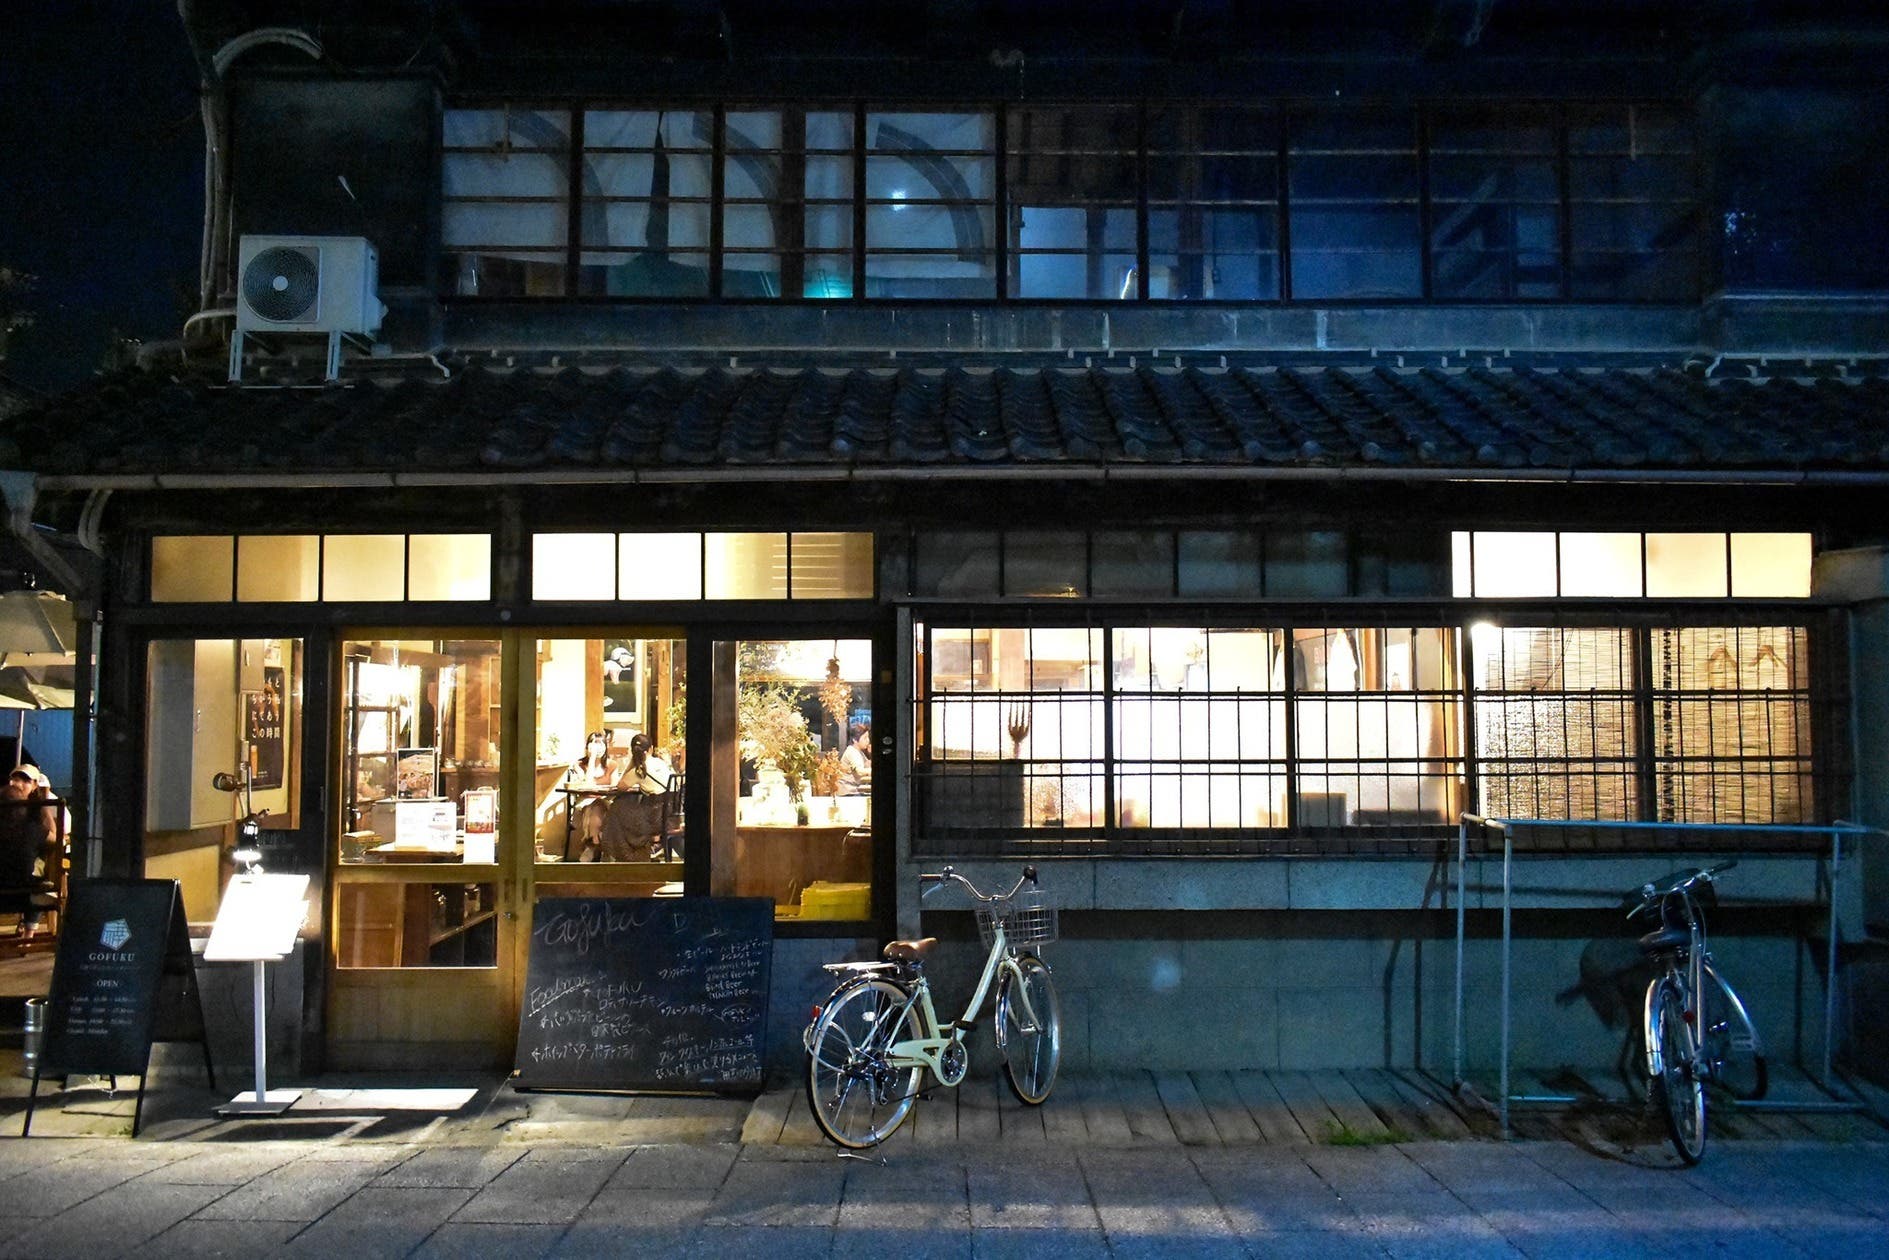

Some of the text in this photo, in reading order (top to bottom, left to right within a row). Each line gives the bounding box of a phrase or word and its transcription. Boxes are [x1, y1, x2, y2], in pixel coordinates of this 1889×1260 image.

[251, 726, 281, 739] この時間
[88, 952, 135, 961] GOFUKU
[96, 979, 119, 987] OPEN
